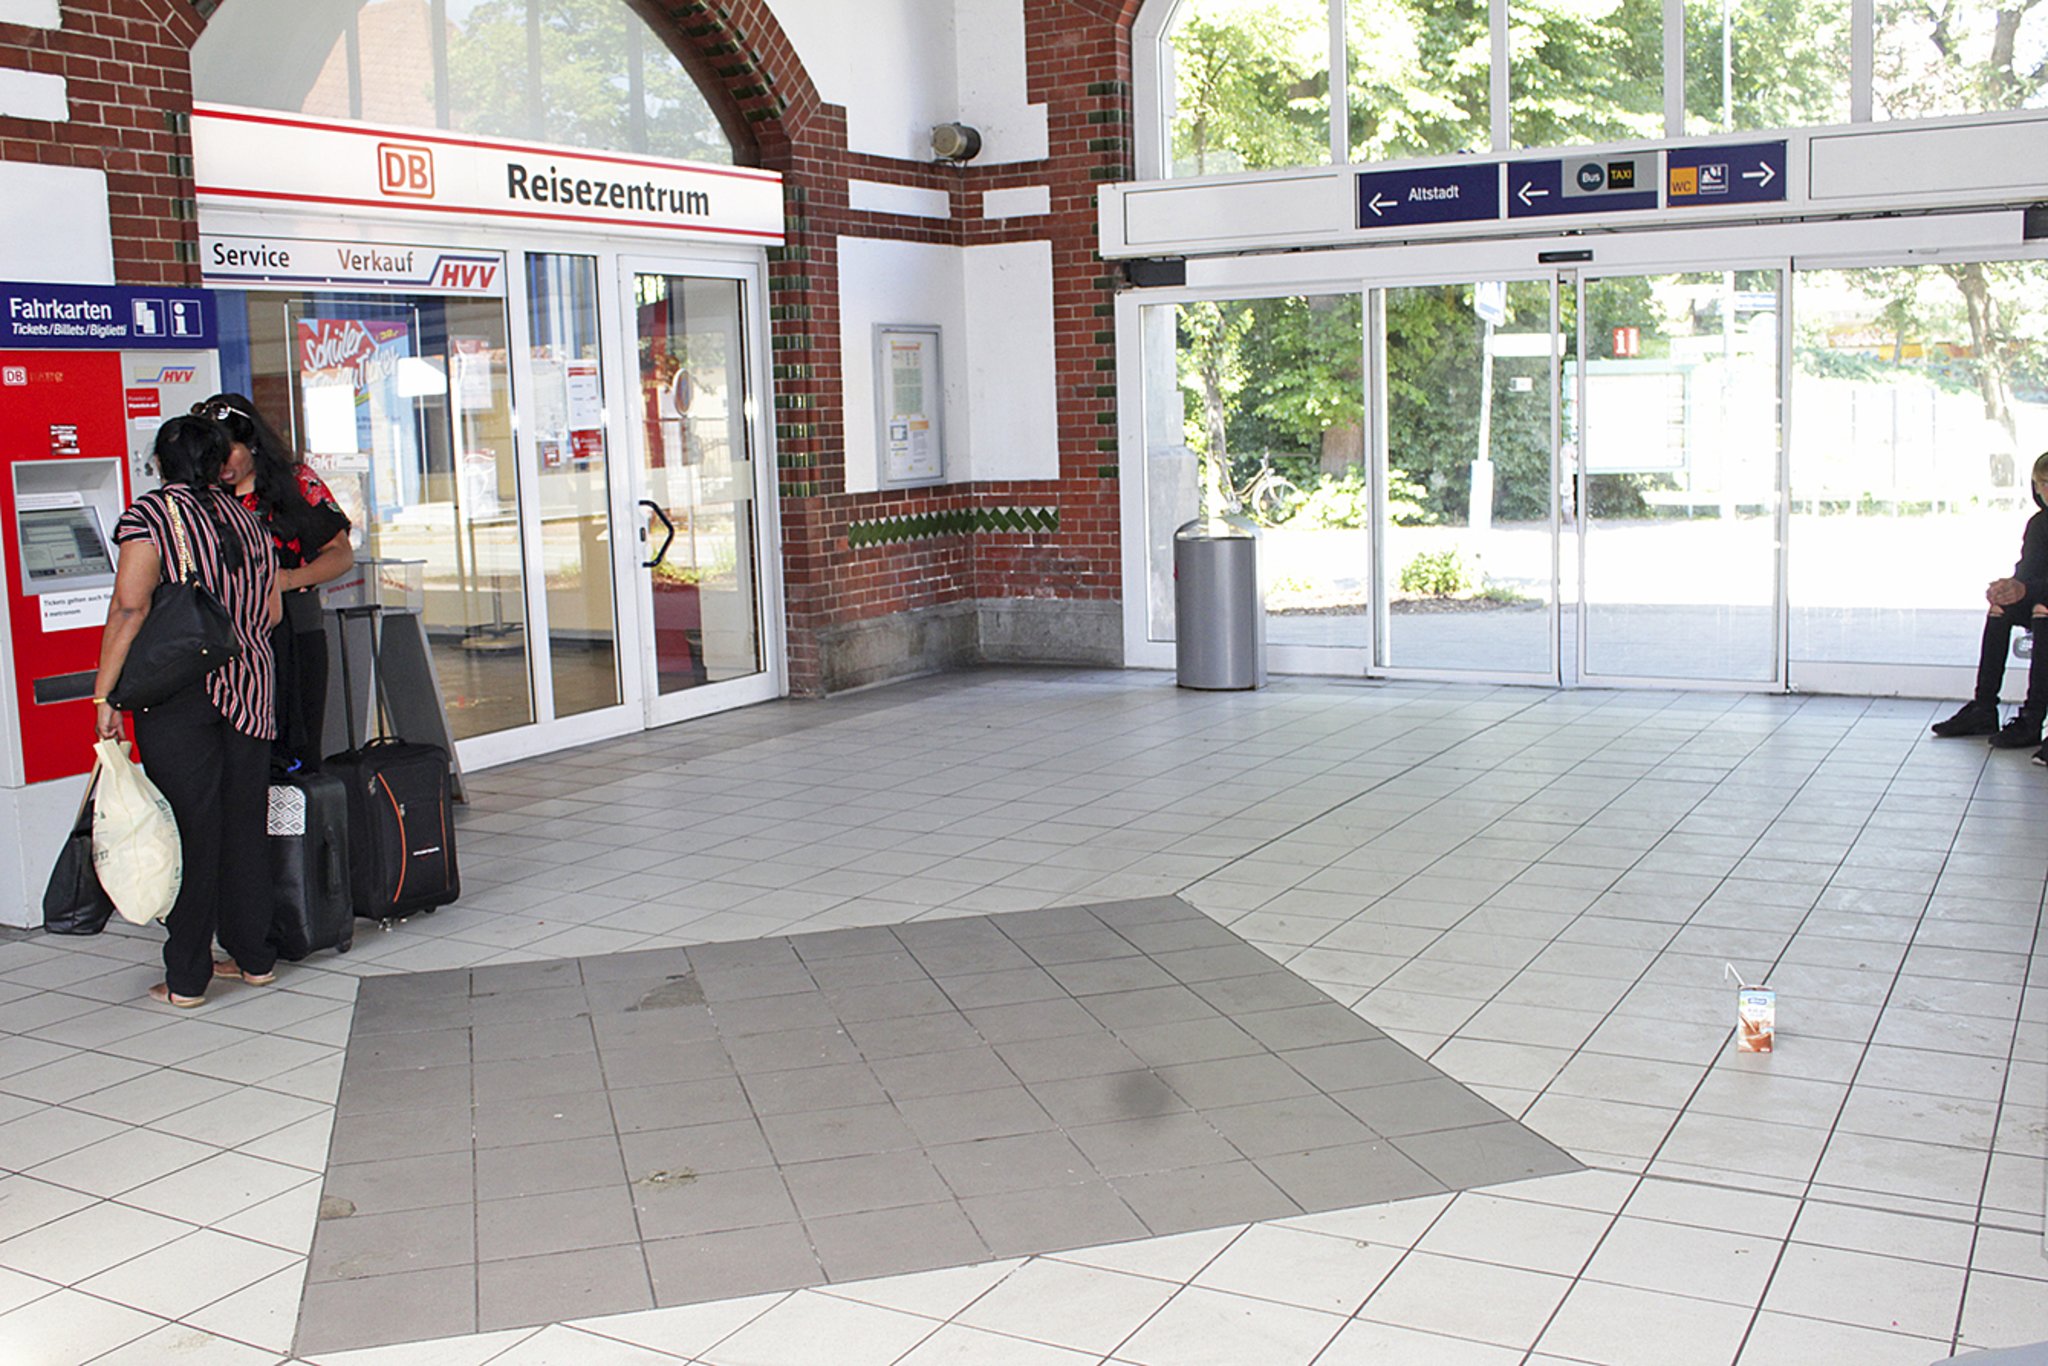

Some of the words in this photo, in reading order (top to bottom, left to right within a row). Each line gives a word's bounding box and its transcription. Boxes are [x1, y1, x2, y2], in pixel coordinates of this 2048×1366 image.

[385, 150, 428, 191] DB
[1582, 171, 1602, 183] Bus
[1611, 169, 1632, 180] TAXI
[506, 164, 710, 217] Reisezentrum
[1408, 183, 1461, 202] Altstadt
[1671, 180, 1692, 193] WC
[213, 243, 291, 269] Service
[338, 247, 415, 274] Verkauf
[441, 262, 497, 289] HVV
[10, 298, 113, 320] Fahrkarten
[12, 321, 127, 338] Tickets/Billets/Biglietti
[304, 321, 365, 372] Schüler
[163, 371, 194, 382] HVV
